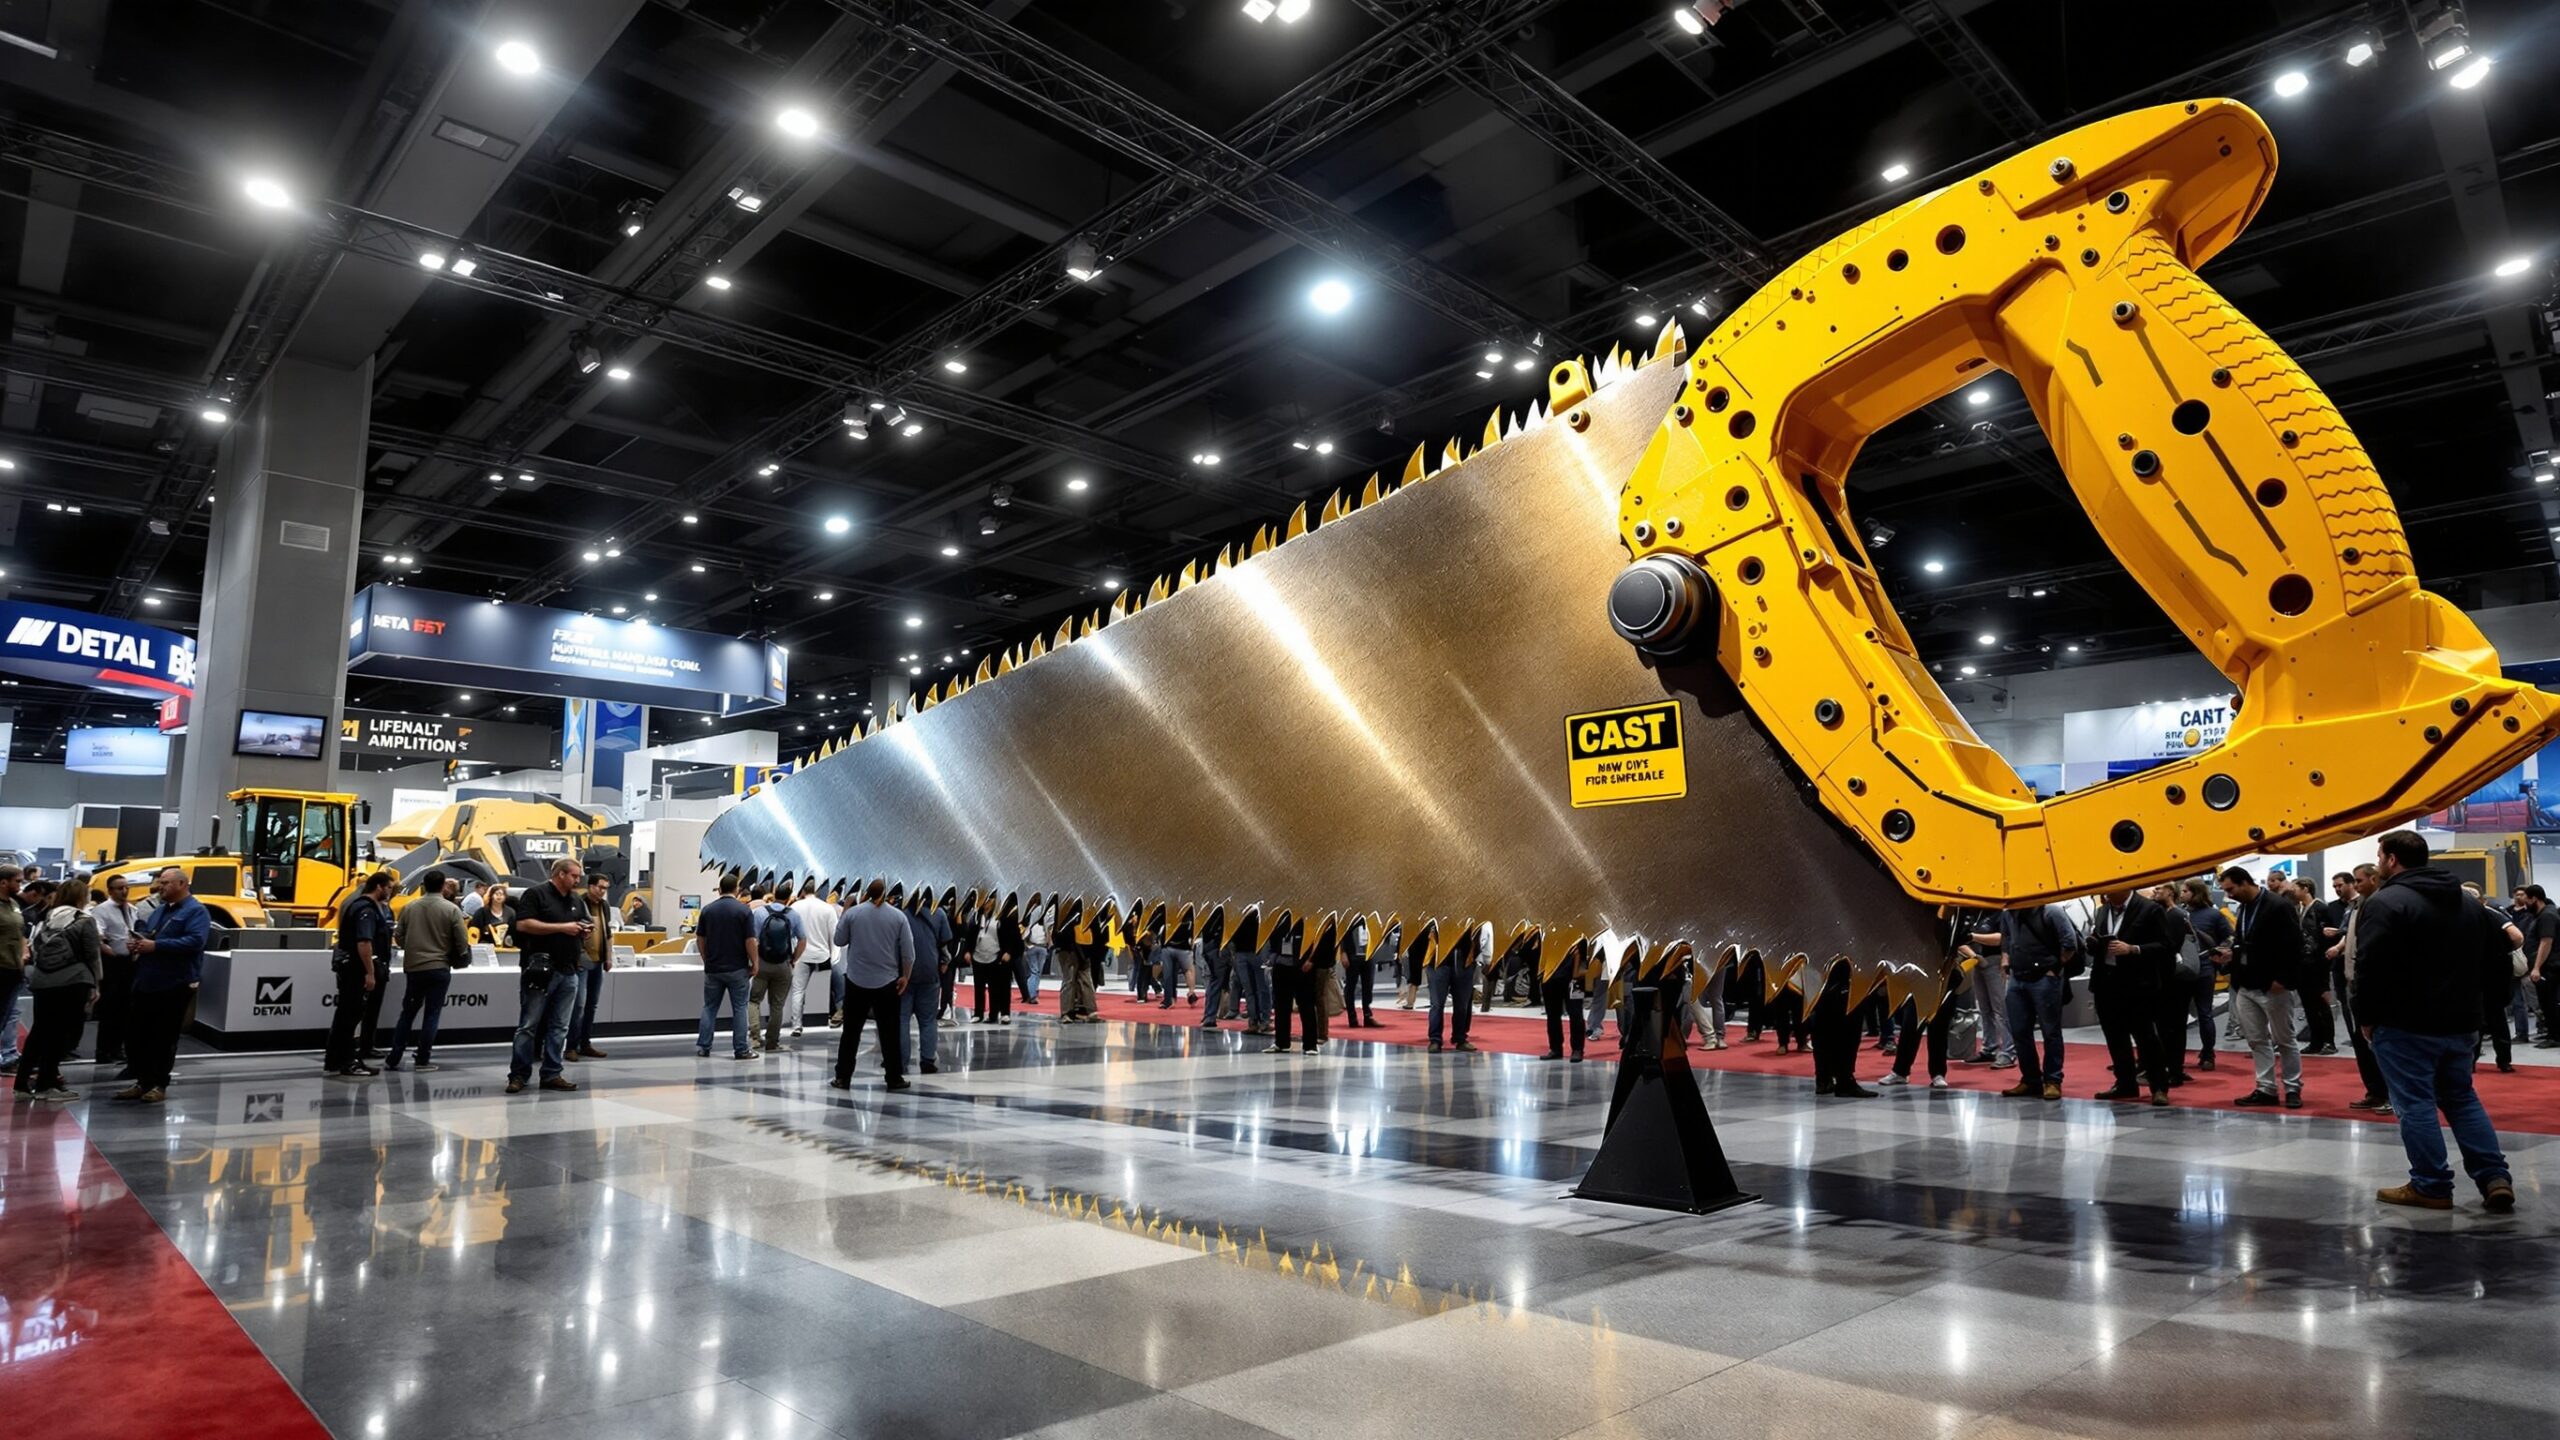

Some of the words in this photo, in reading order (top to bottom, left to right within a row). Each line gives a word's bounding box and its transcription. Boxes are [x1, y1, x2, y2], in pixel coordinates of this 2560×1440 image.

[57, 623, 156, 669] DETAL
[369, 719, 443, 737] LIFENALT
[1578, 713, 1666, 753] CAST
[368, 734, 457, 753] AMPLITION
